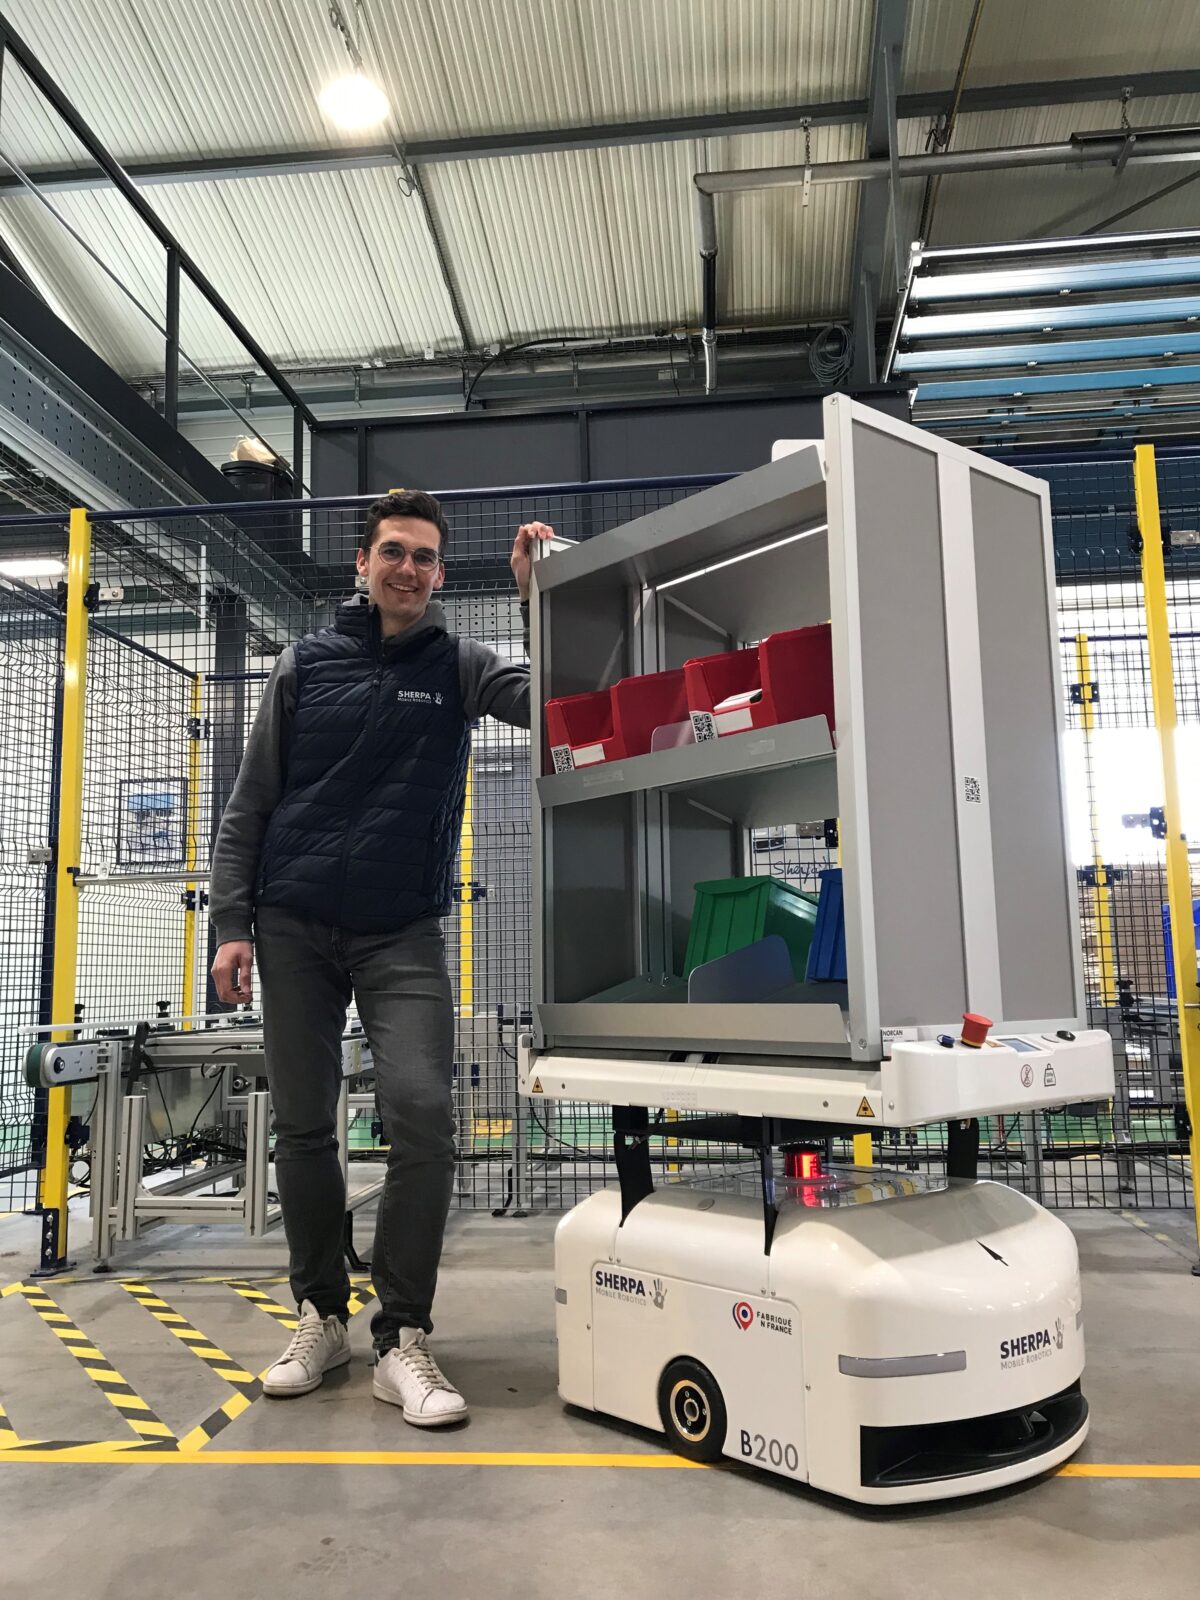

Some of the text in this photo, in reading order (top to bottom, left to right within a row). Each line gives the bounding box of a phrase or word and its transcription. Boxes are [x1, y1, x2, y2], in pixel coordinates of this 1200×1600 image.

[397, 690, 432, 700] SHERPA
[882, 1029, 904, 1037] NORCAN
[595, 1270, 646, 1297] SHERPA
[595, 1286, 647, 1306] MOBILE ROBOTICS
[766, 1321, 793, 1336] FRANCE
[1000, 1329, 1051, 1359] SHERPA
[1001, 1348, 1053, 1370] MOBILE ROBOTICS
[740, 1429, 799, 1472] B200
